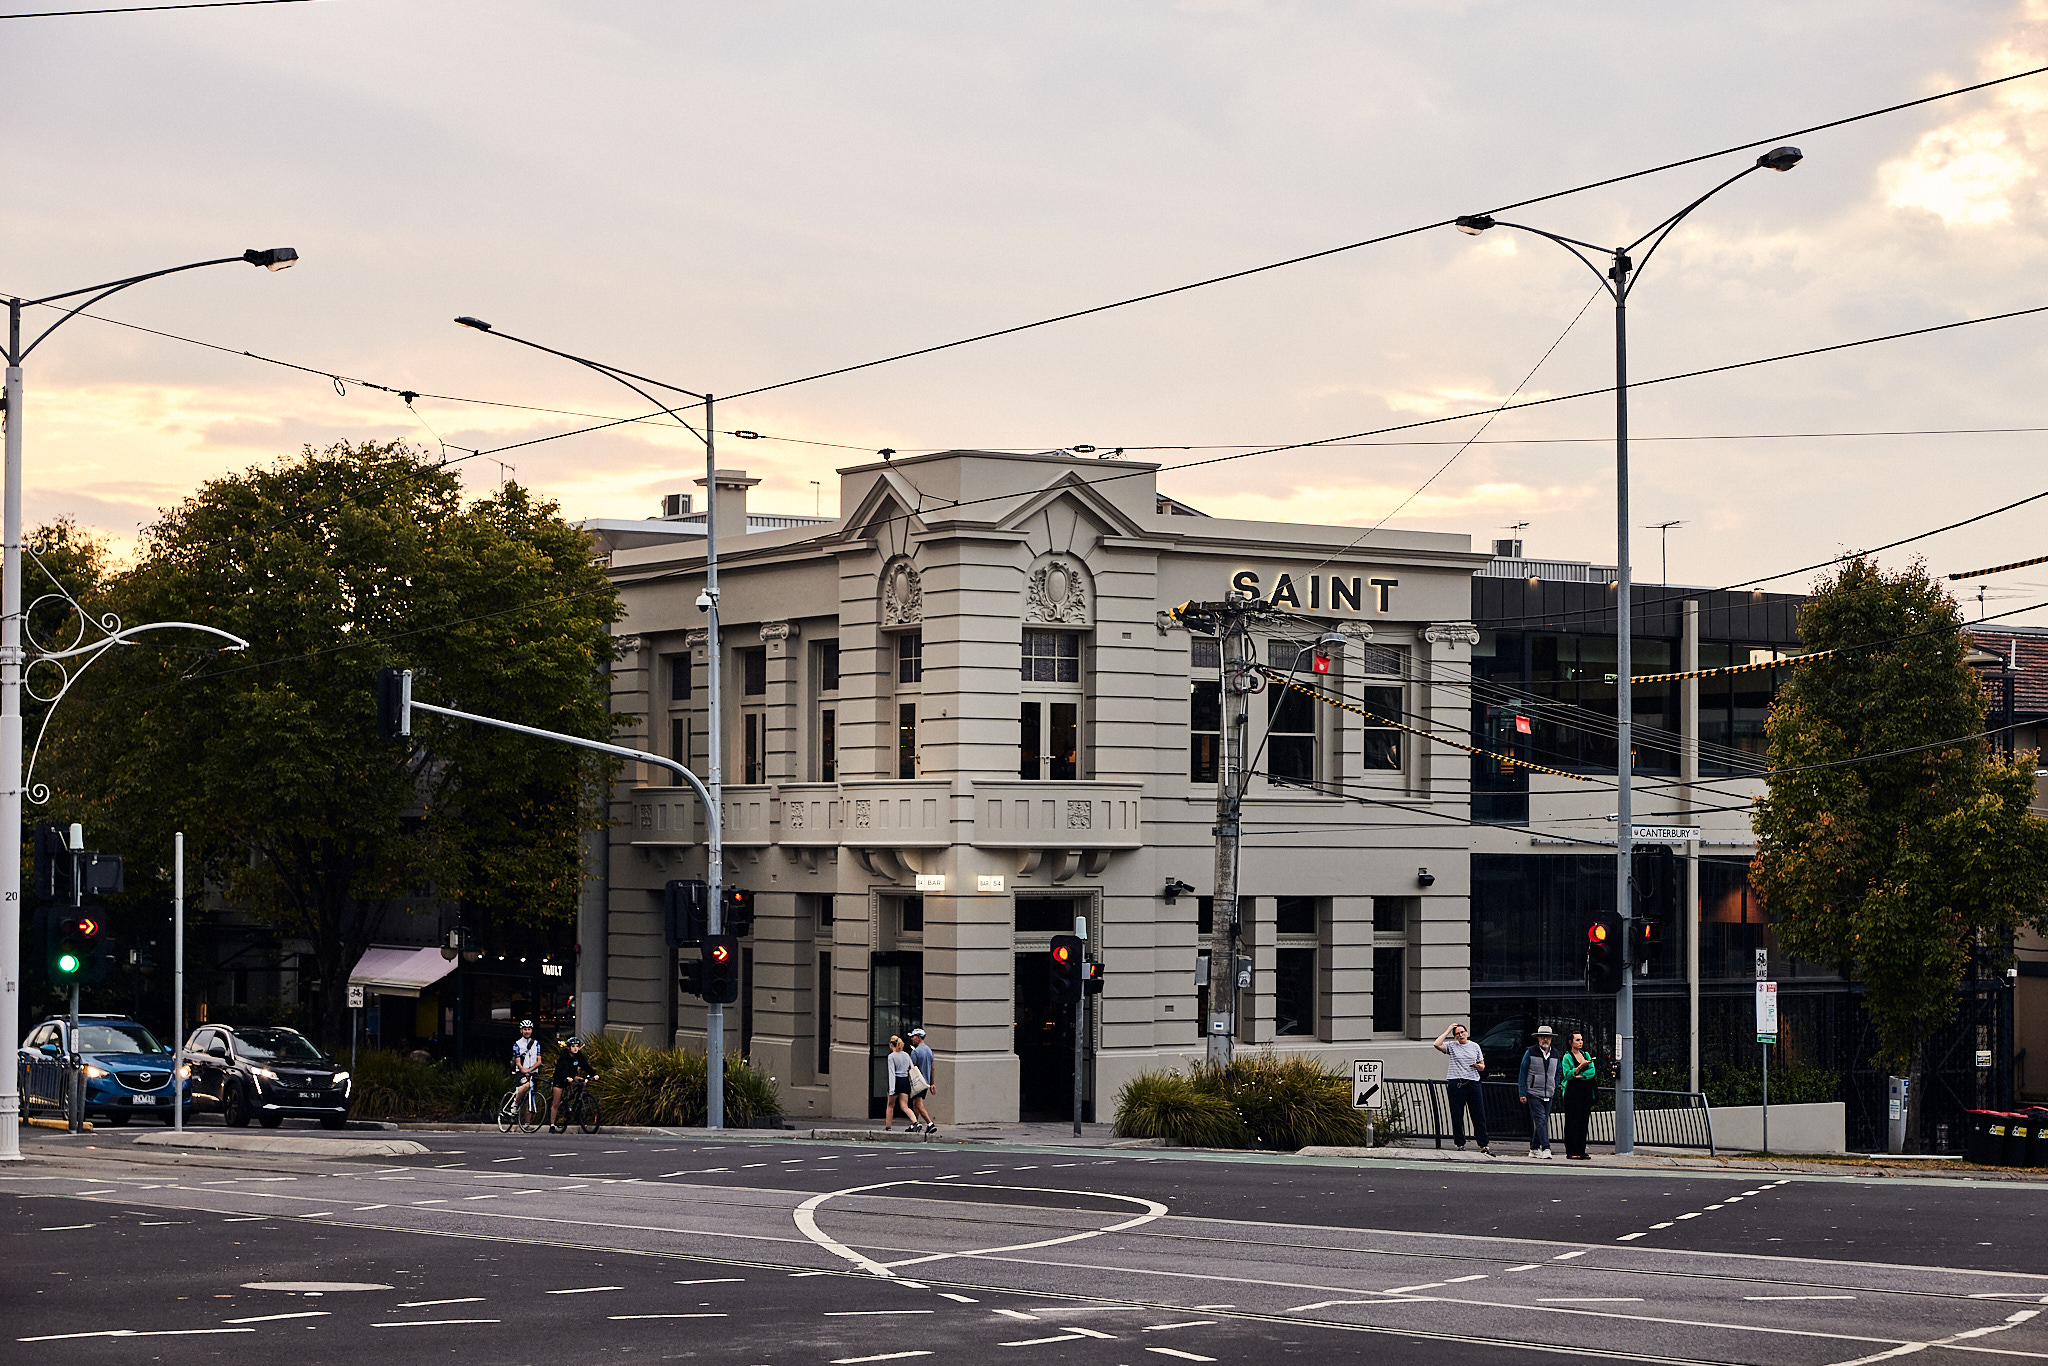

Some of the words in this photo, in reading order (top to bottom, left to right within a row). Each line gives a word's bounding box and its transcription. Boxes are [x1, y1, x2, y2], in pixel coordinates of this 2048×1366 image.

[1232, 571, 1399, 612] SAINT
[1639, 828, 1690, 838] CANTERBURY
[5, 891, 18, 901] 20
[542, 964, 562, 976] VAULT
[1756, 969, 1767, 978] LANE
[1358, 1064, 1378, 1073] KEEP
[1359, 1074, 1377, 1083] LEFT
